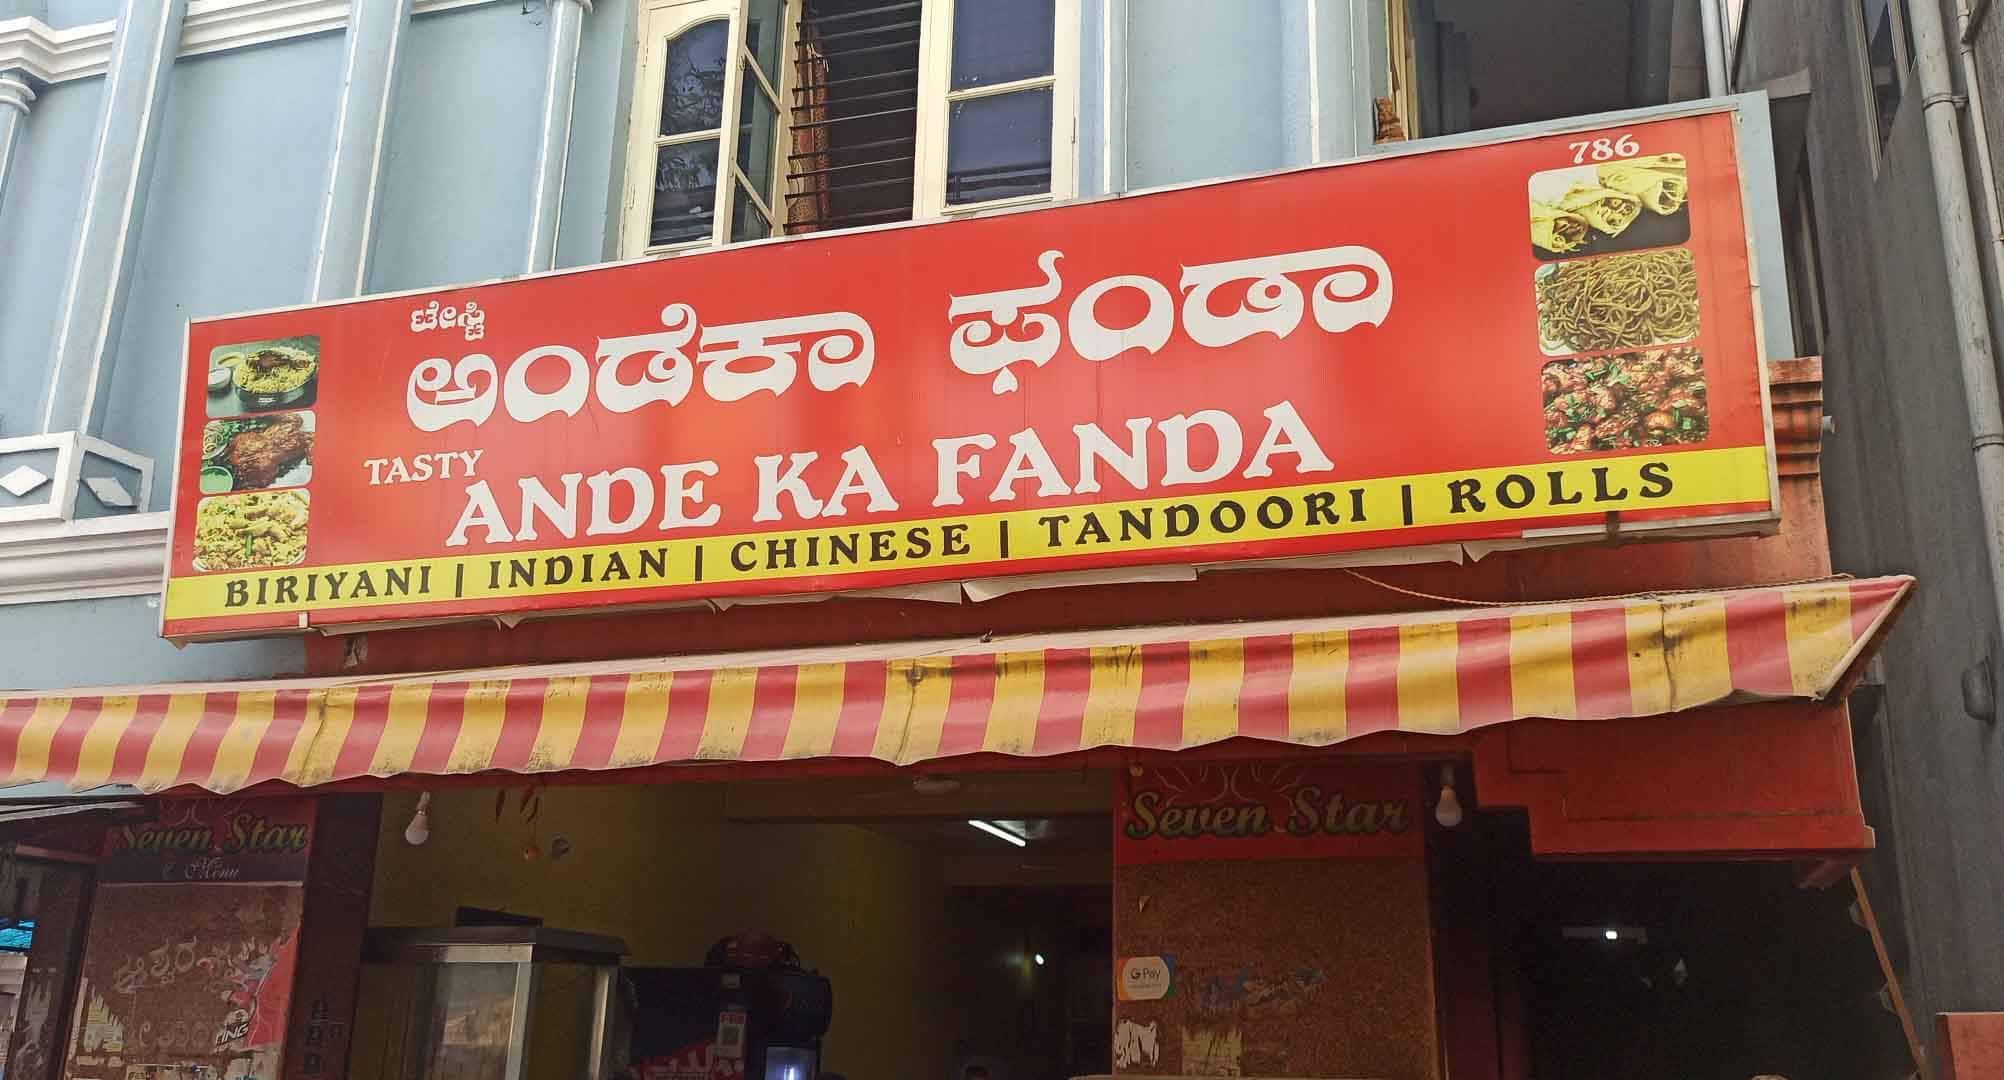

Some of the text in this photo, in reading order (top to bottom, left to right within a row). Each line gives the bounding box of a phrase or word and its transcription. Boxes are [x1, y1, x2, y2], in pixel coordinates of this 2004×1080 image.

[1568, 134, 1641, 164] 786
[410, 300, 486, 342] ಟೇಸ್ಟಿ
[948, 245, 1393, 395] ಫಂಡಾ
[363, 449, 484, 485] TASTY
[446, 400, 1335, 547] ANDE KA FANDA
[224, 565, 431, 608] BIRIYANI
[488, 548, 668, 589] INDIAN
[731, 524, 970, 572] CHINESE
[1038, 488, 1367, 548] TANDOORI
[1447, 462, 1673, 514] ROLLS
[226, 811, 308, 852] Star
[1126, 785, 1410, 839] Seven Star
